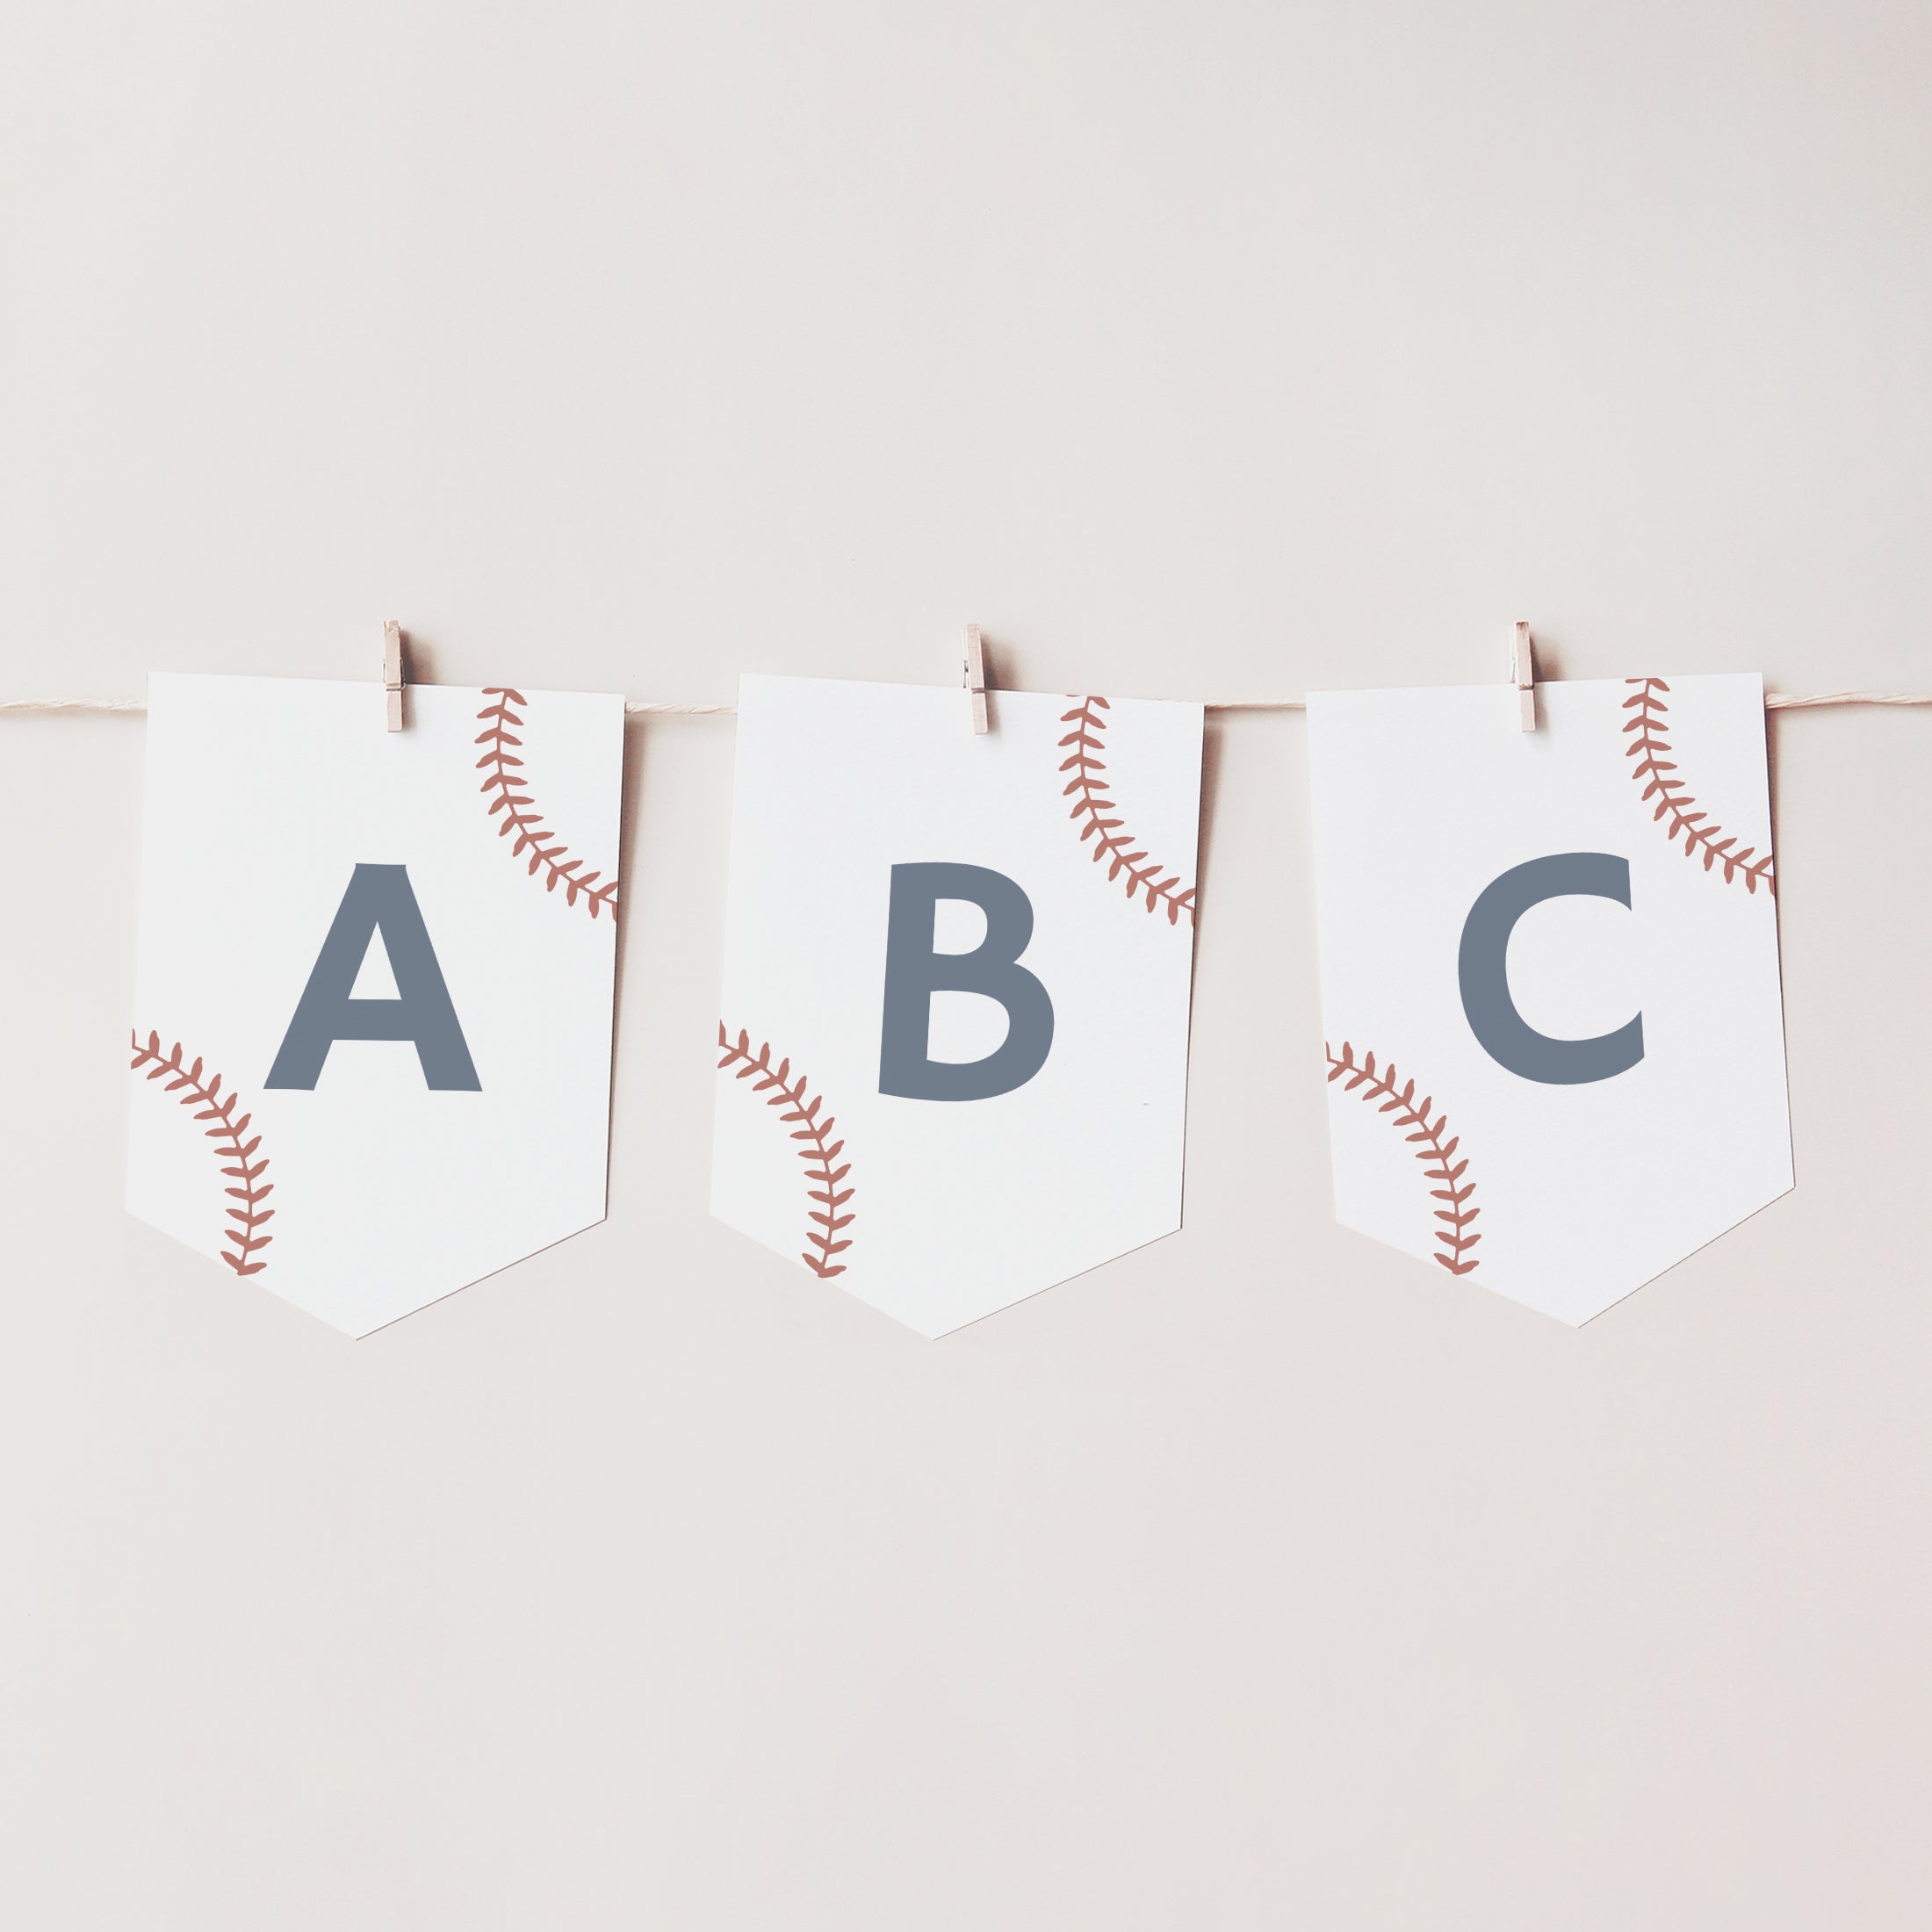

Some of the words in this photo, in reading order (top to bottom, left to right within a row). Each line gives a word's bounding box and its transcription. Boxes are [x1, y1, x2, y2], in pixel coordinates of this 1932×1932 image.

[263, 862, 482, 1092] A
[878, 861, 1055, 1102] B
[1458, 852, 1645, 1085] C
